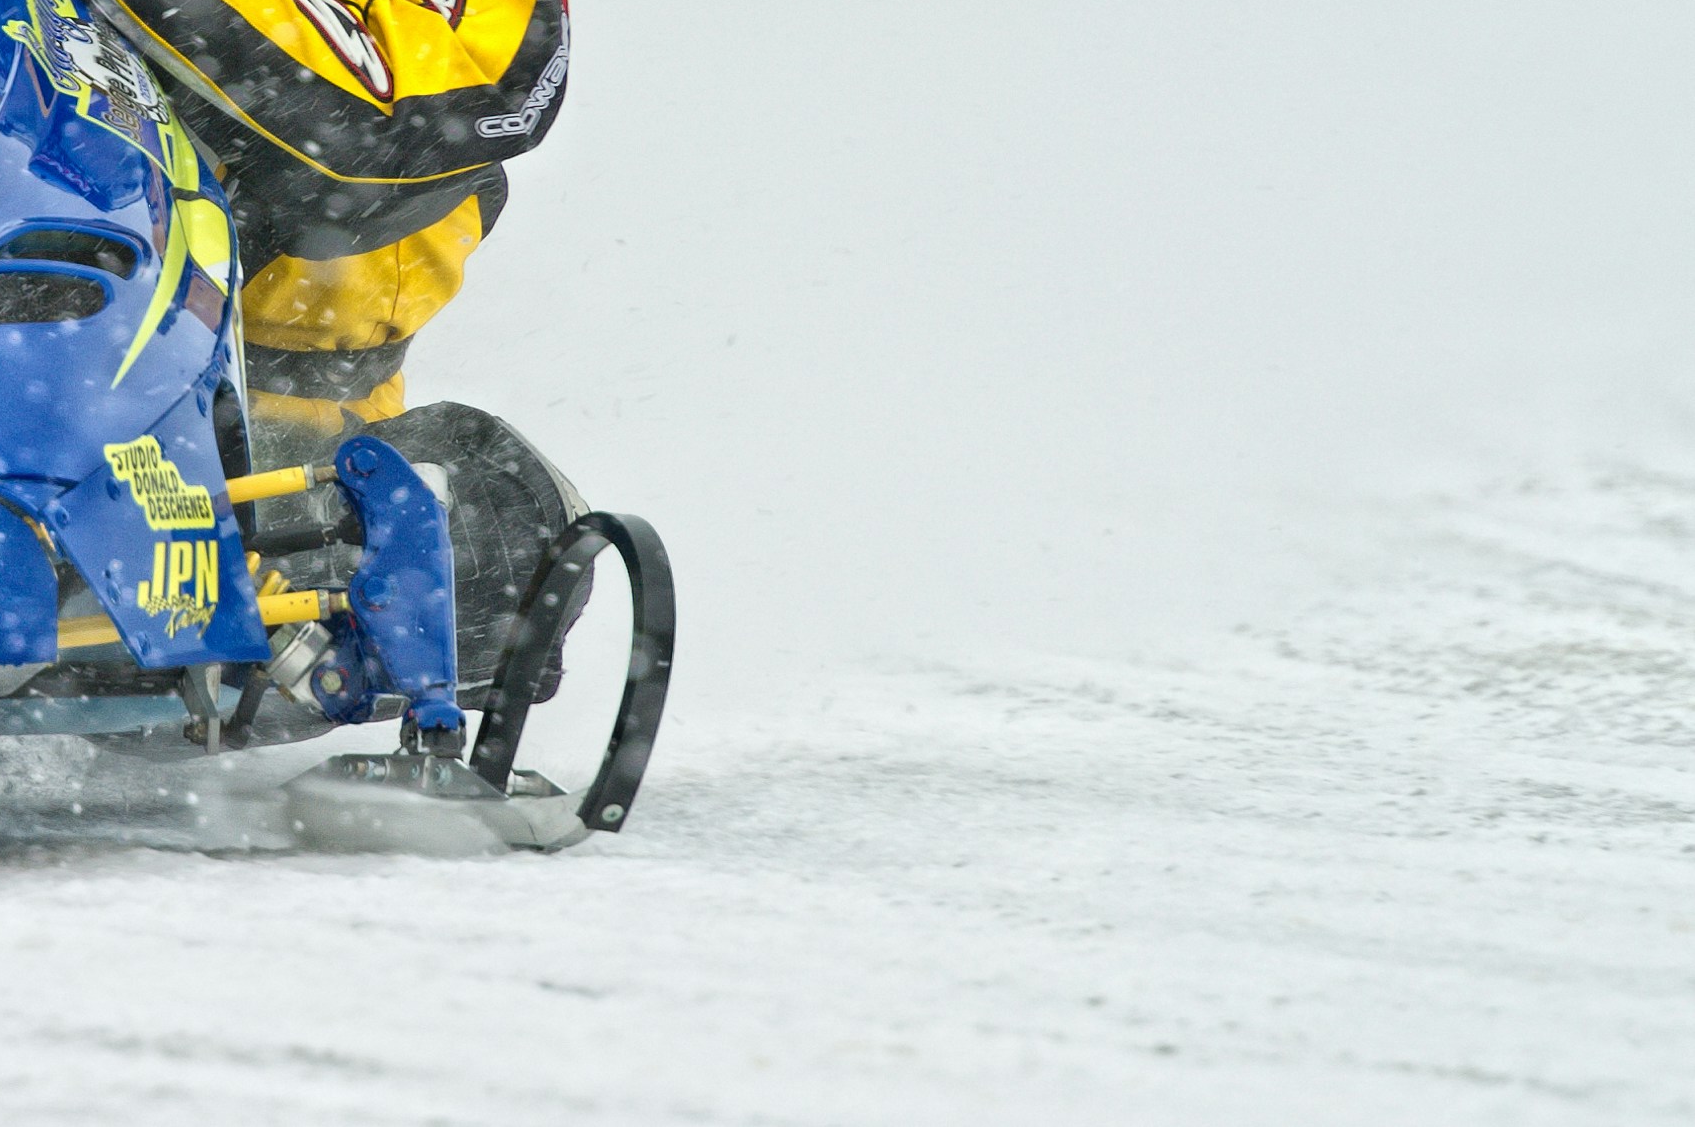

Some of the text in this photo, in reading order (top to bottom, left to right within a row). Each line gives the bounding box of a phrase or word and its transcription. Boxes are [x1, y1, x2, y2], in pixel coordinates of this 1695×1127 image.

[111, 444, 159, 472] STUDIO
[134, 469, 179, 496] DONALD
[137, 540, 218, 609] JPN
